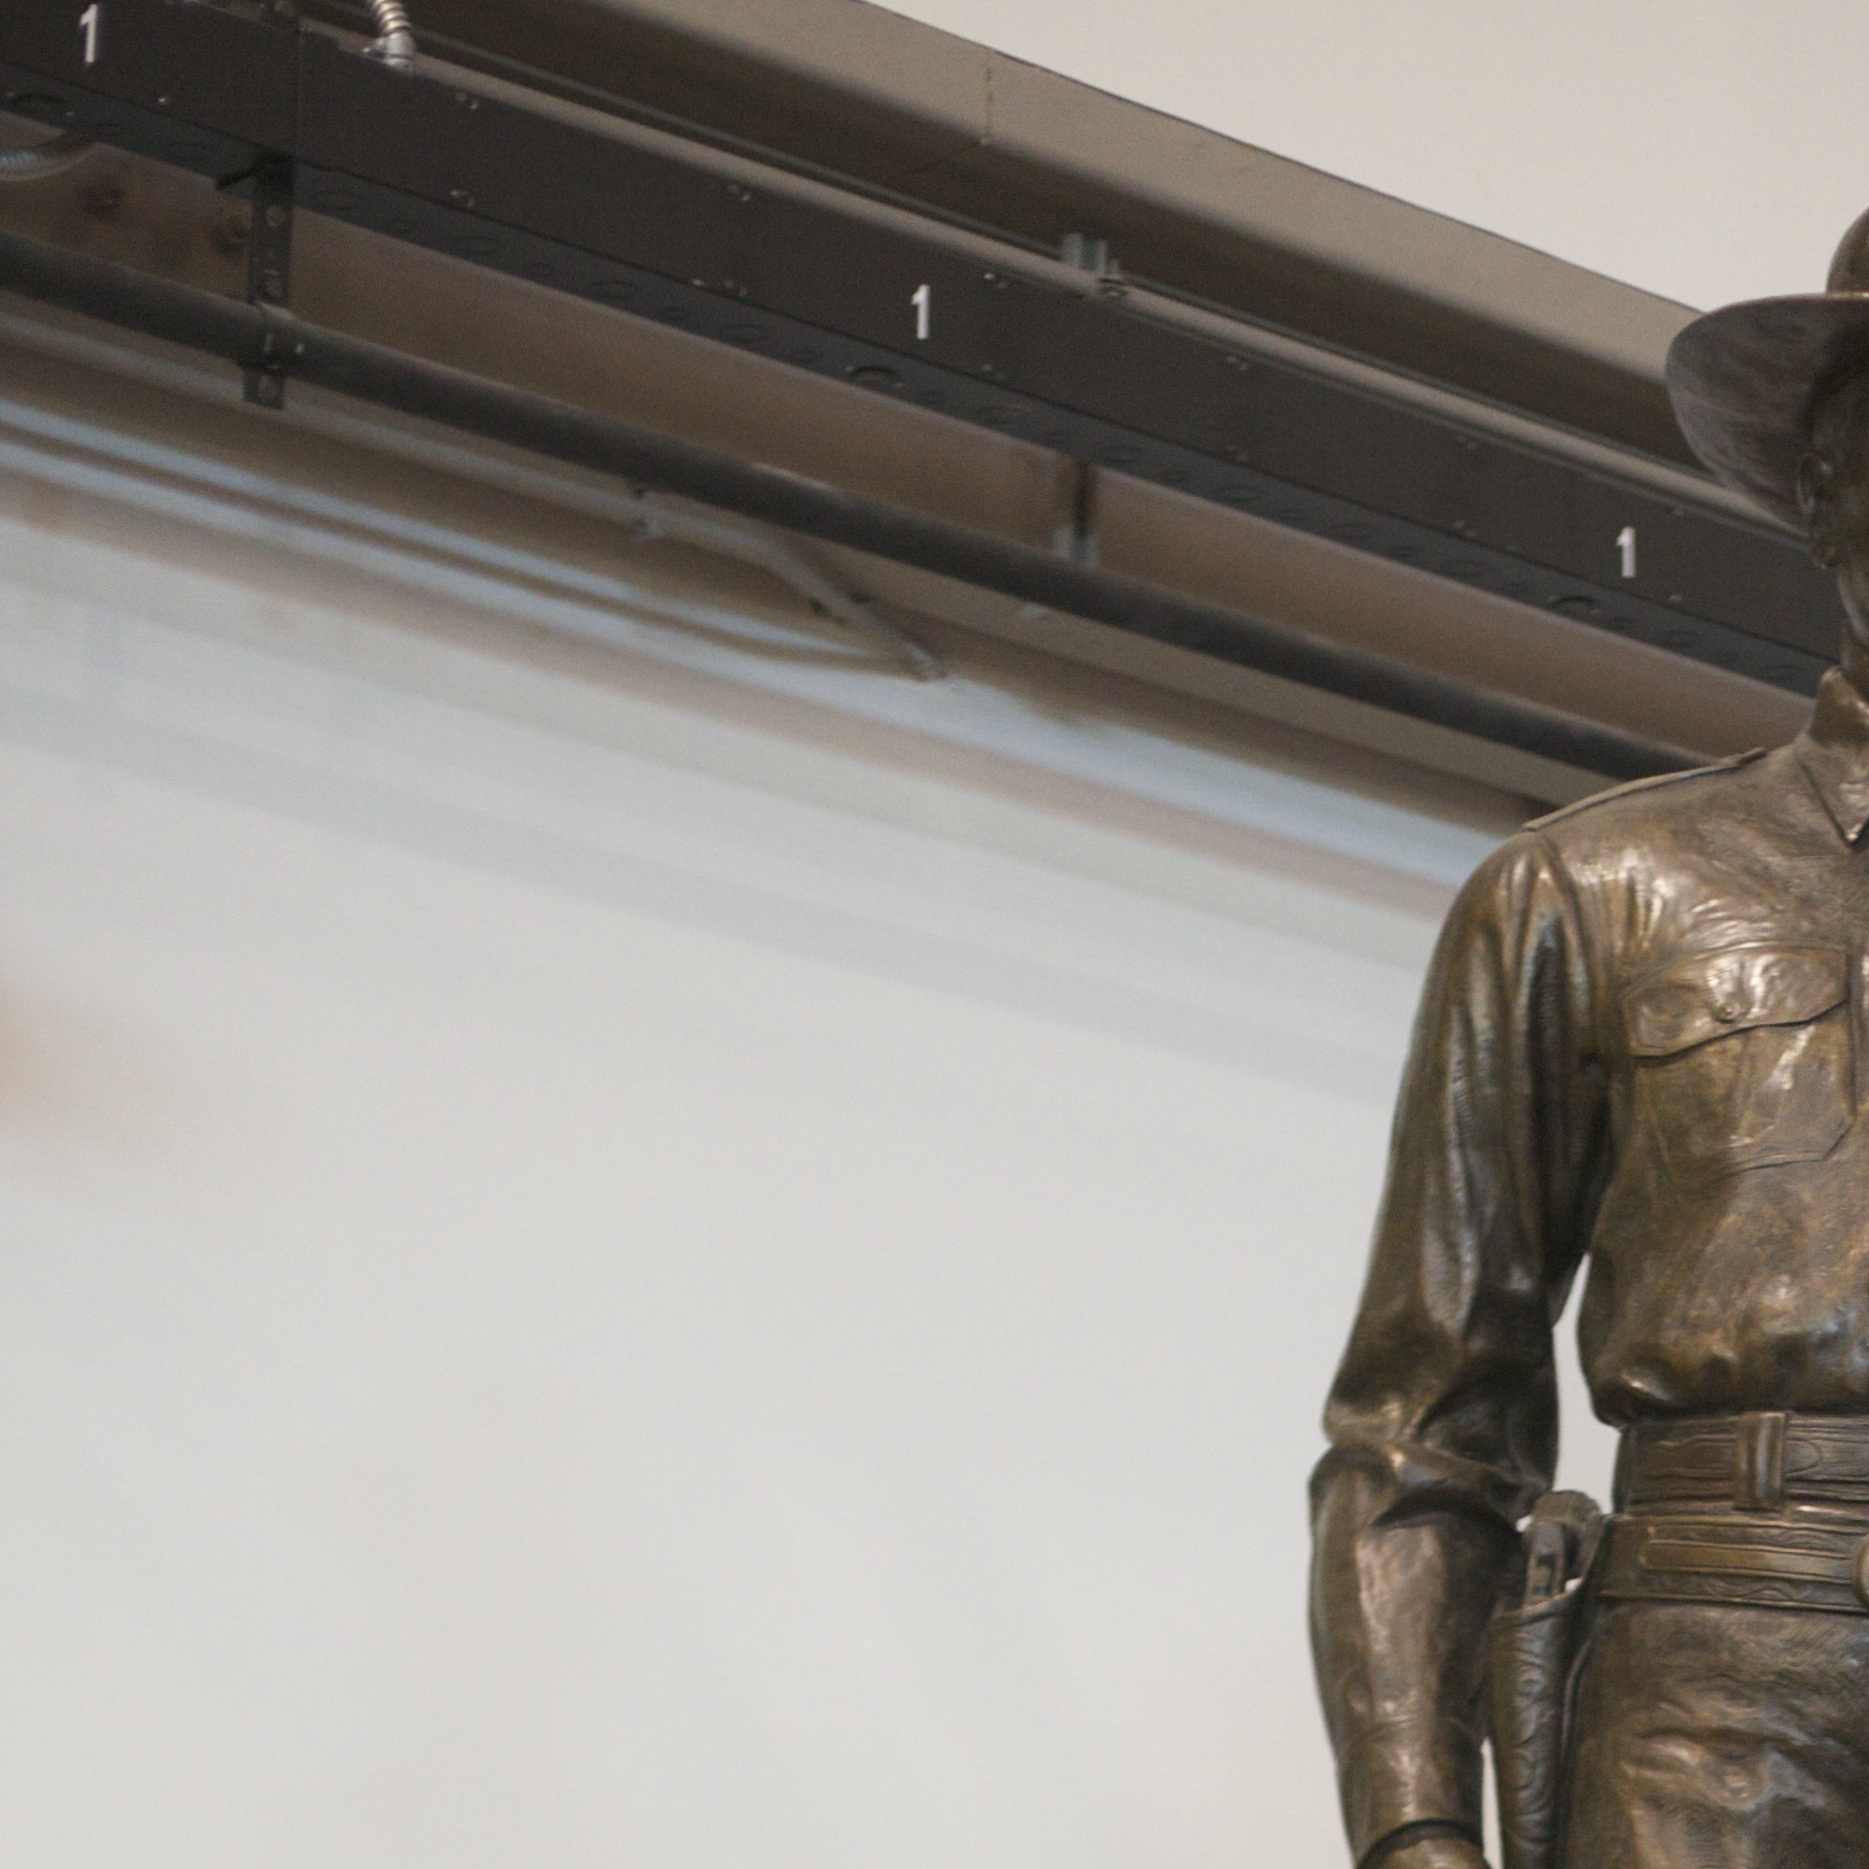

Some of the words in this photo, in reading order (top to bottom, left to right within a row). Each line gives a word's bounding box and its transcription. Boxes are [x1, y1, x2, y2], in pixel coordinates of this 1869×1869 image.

[78, 3, 99, 65] 1
[911, 284, 930, 341] 1
[1616, 527, 1635, 578] 1
